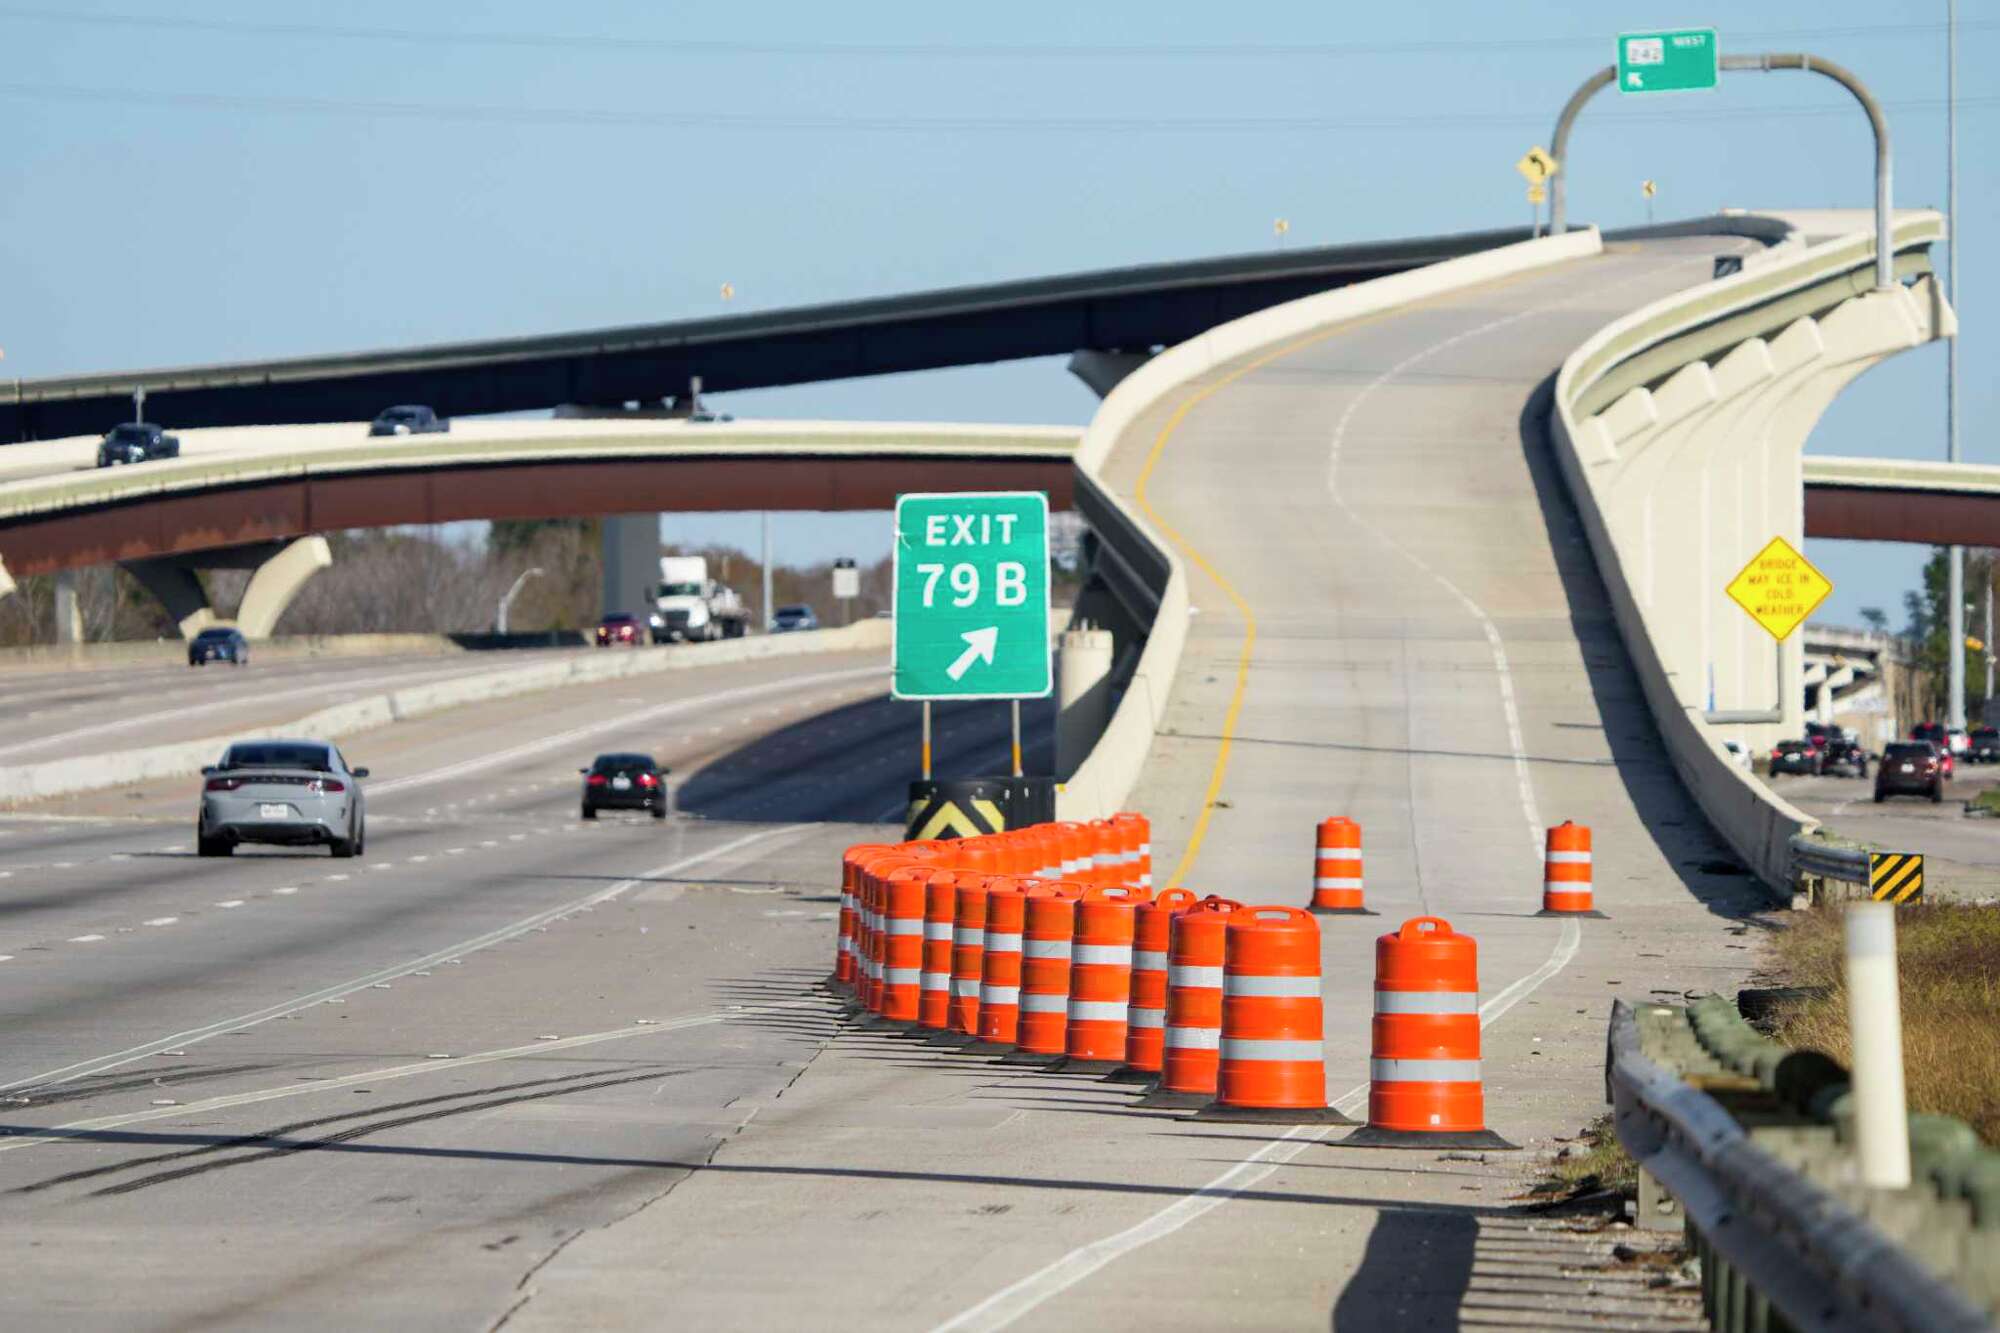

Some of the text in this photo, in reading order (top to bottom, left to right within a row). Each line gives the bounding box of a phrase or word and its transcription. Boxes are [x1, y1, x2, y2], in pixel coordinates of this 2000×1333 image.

[925, 514, 1018, 546] EXIT
[1760, 559, 1797, 570] BRIDGE
[916, 561, 1027, 608] 79 B
[1748, 573, 1810, 585] MAY ICE IN
[1756, 604, 1804, 615] WEATHER
